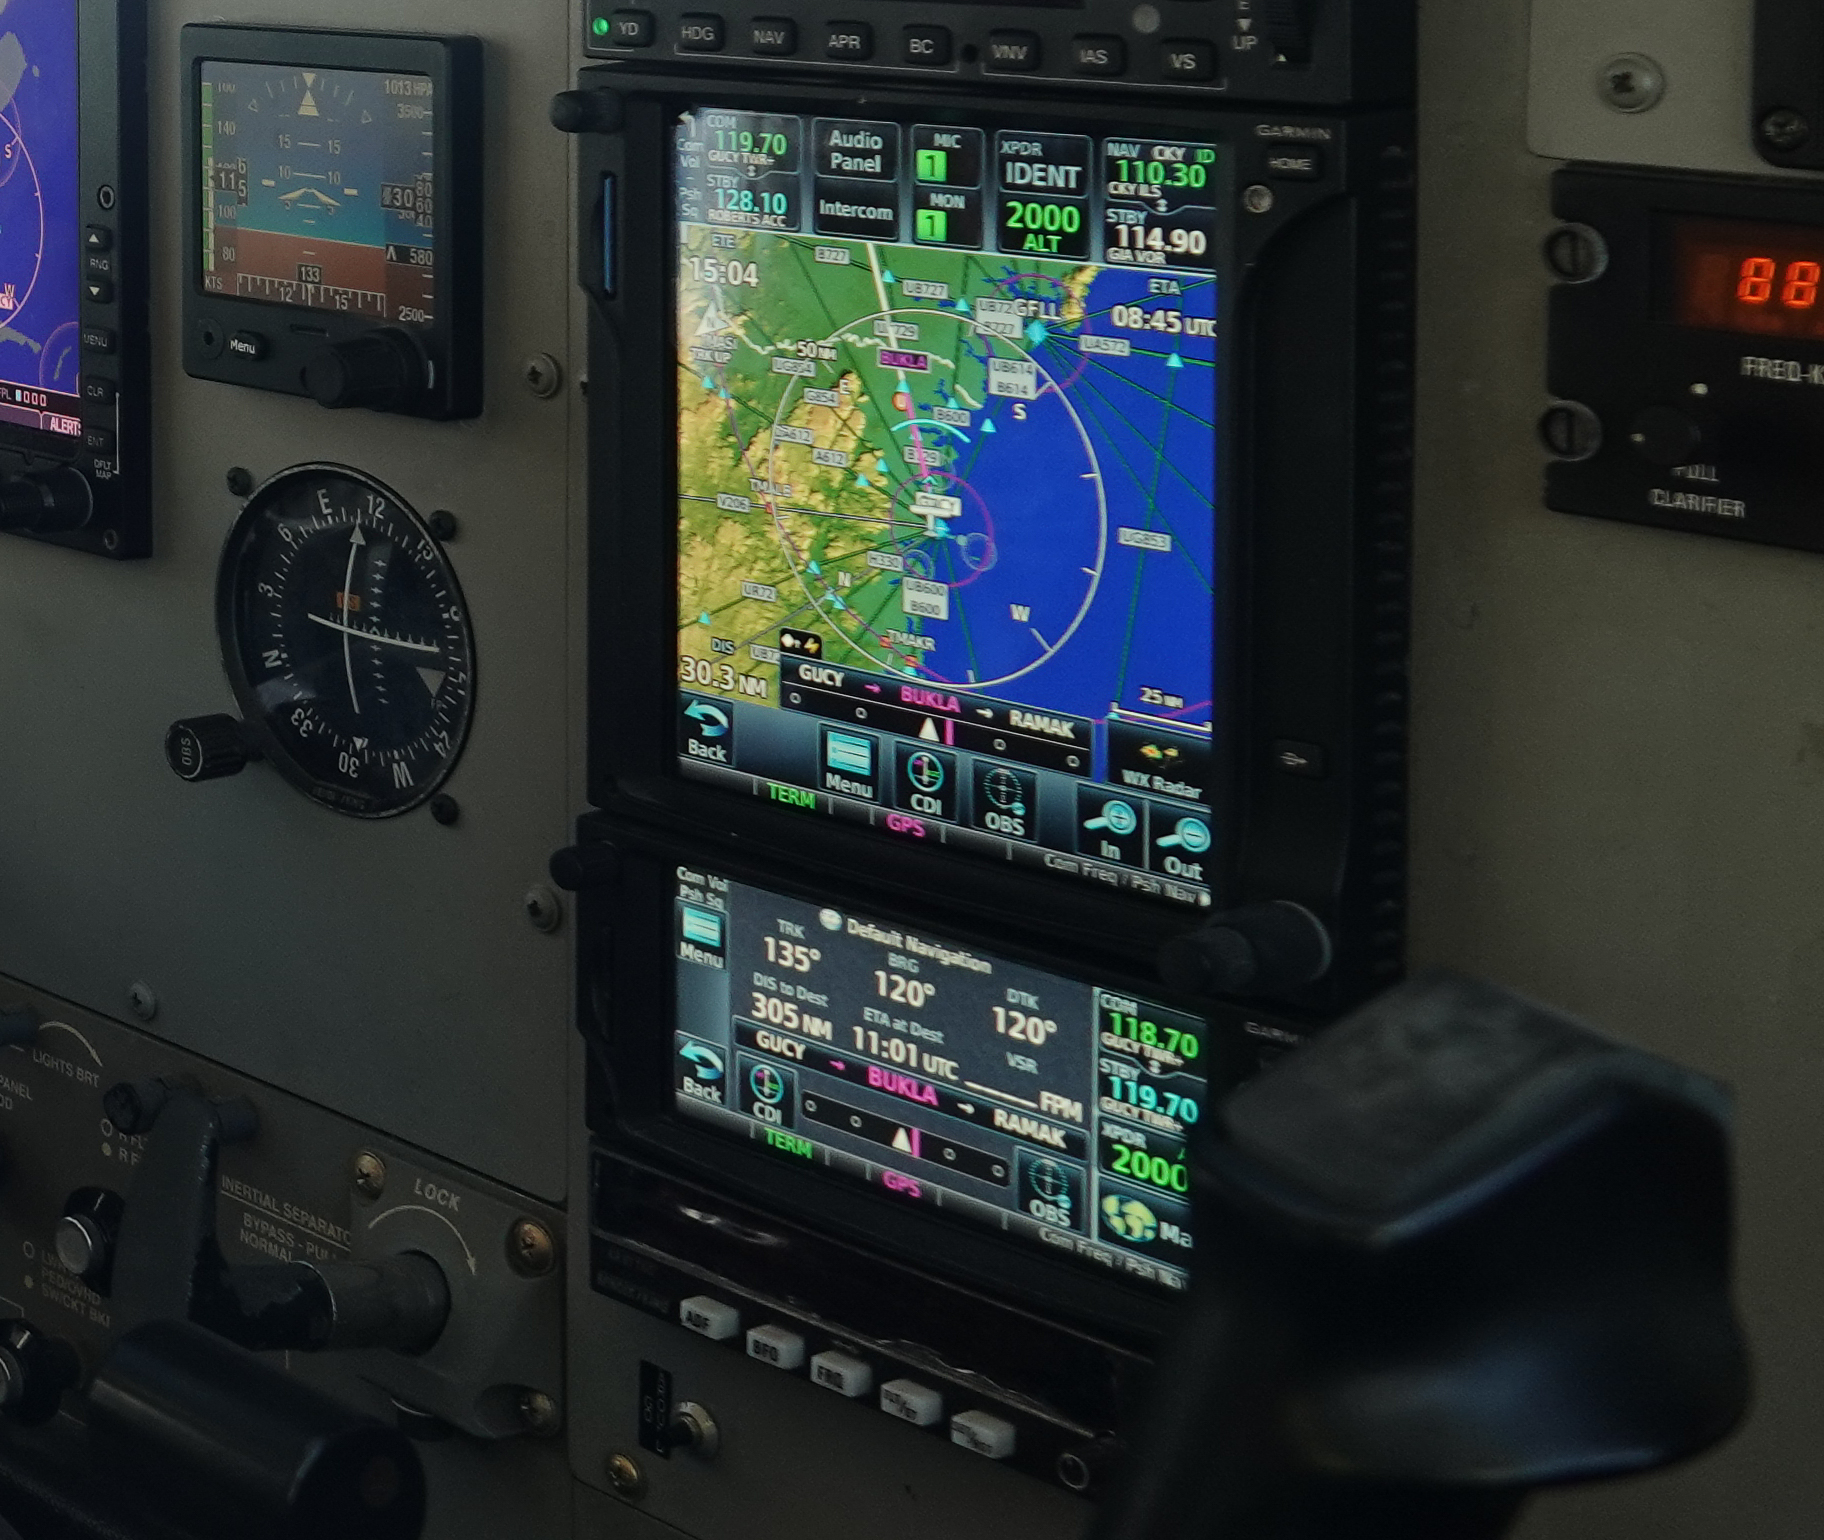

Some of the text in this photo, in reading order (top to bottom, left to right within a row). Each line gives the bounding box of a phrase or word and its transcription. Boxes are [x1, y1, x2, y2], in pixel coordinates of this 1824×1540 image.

[619, 21, 639, 36] YD
[681, 25, 715, 42] HDG
[754, 29, 786, 45] NAV
[828, 34, 862, 50] APR
[910, 38, 934, 54] BC
[1232, 35, 1259, 51] UP
[1169, 53, 1197, 69] VS
[217, 120, 236, 136] 140
[829, 129, 883, 150] Audio
[1254, 124, 1332, 141] GARMIN
[328, 139, 341, 155] 15
[830, 152, 882, 174] Panel
[1005, 161, 1083, 190] IDENT
[1115, 159, 1207, 188] 110.30
[819, 198, 894, 221] Intercom
[1005, 200, 1081, 233] 2000
[1022, 233, 1063, 254] ALT
[1114, 224, 1208, 256] 114.90
[90, 258, 109, 271] RNG
[301, 266, 320, 283] 133
[690, 256, 760, 288] 15:04
[204, 274, 223, 291] KTS
[1111, 305, 1183, 334] 08:45
[83, 333, 108, 348] MENU
[229, 338, 256, 355] Menu
[86, 385, 104, 398] CLR
[317, 489, 333, 515] E
[366, 495, 386, 520] 12
[680, 656, 735, 692] 30.3
[798, 664, 845, 688] GUCY
[900, 685, 961, 713] BUKLA
[688, 738, 728, 764] Back
[766, 781, 816, 810] TERM
[825, 772, 874, 799] Menu
[910, 793, 942, 816] CDI
[885, 813, 927, 838] GPS
[984, 810, 1026, 837] OBS
[1164, 855, 1204, 882] Out
[680, 940, 725, 970] Menu
[751, 991, 833, 1042] 305 NM
[754, 1029, 806, 1061] GUCY
[1108, 1011, 1200, 1060] 118.70
[852, 1025, 960, 1080] 11:01 UTC
[33, 1048, 100, 1088] LIGHTS BRT
[682, 1075, 723, 1106] Back
[867, 1065, 940, 1108] BUKLA
[1108, 1075, 1200, 1125] 119.70
[752, 1102, 783, 1127] CDI
[763, 1126, 814, 1160] TERM
[221, 1174, 281, 1212] INERTIAL
[414, 1177, 462, 1212] LOCK
[881, 1169, 923, 1199] GPS
[1028, 1198, 1072, 1228] OBS
[243, 1212, 295, 1248] BYPASS
